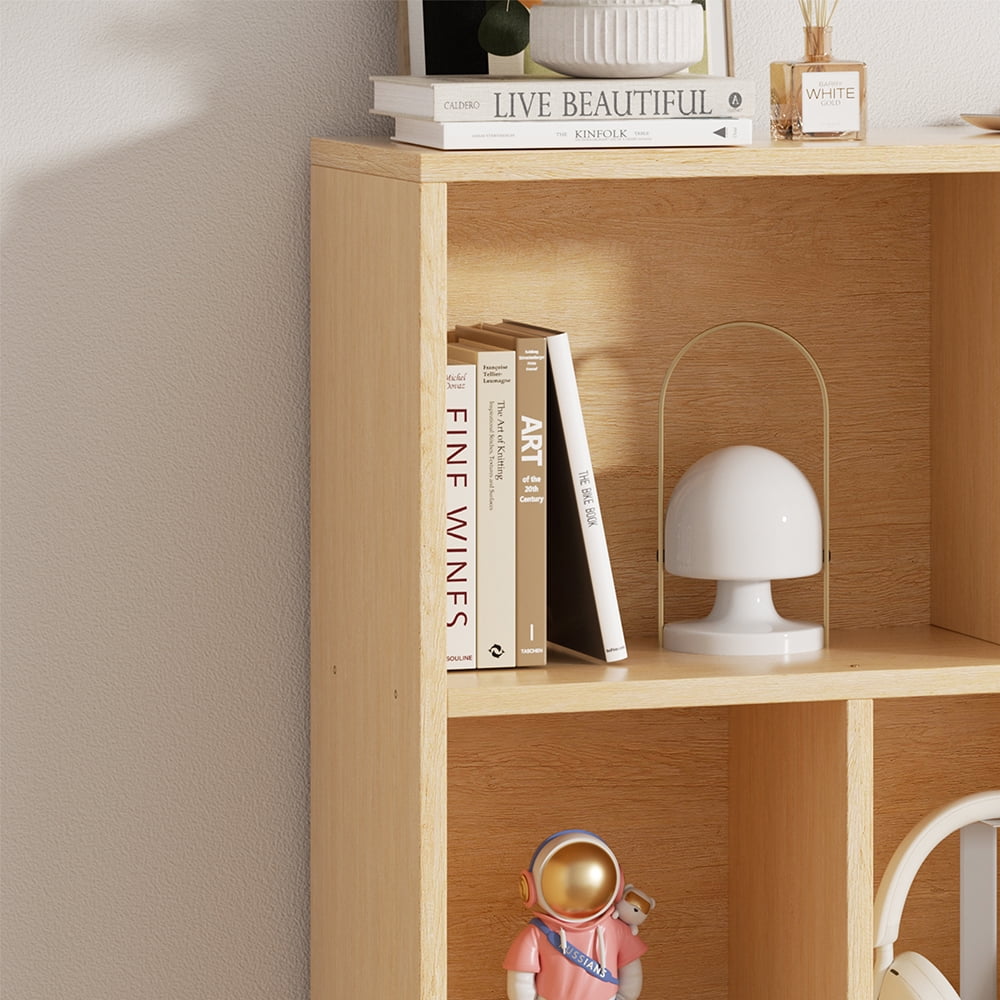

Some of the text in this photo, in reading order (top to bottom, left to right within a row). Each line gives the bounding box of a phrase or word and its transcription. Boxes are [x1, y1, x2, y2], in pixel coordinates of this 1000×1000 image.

[806, 87, 855, 99] WHITE
[444, 101, 481, 110] CALDERO
[494, 90, 713, 118] LIVE BEAUTIFUL
[575, 129, 627, 138] KINFOLK
[494, 400, 506, 481] The Art of Knitting
[521, 416, 542, 466] ART
[522, 475, 541, 483] of the
[519, 495, 544, 504] Century
[578, 470, 598, 528] THE BIKE BOOK
